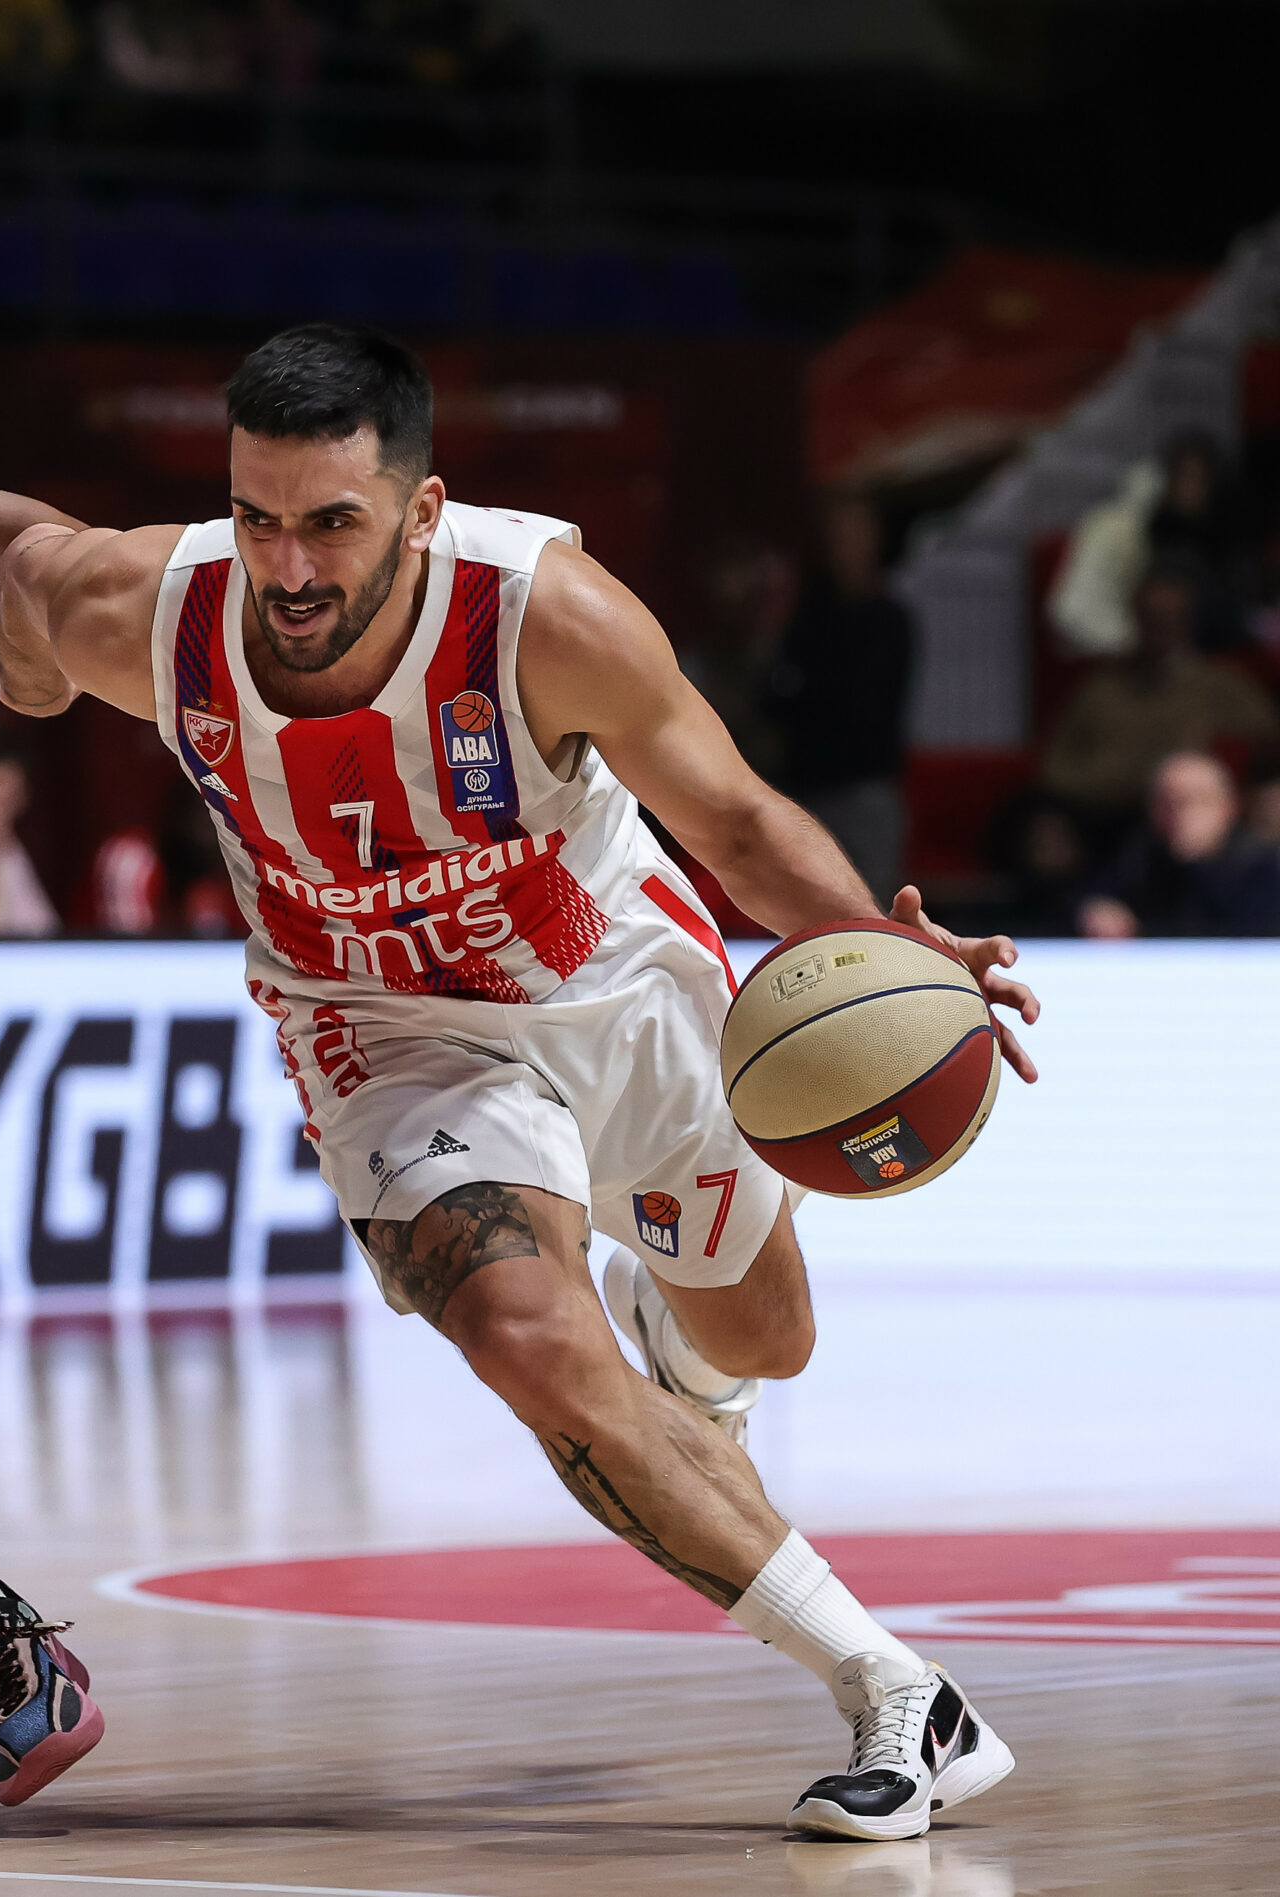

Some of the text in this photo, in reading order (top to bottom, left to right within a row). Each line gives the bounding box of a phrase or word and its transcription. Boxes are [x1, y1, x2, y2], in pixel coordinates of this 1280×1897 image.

[452, 735, 493, 762] ABA
[456, 801, 505, 813] ОСИГУРАЊЕ
[466, 794, 493, 805] ДУНАВ
[329, 800, 375, 868] 7
[264, 831, 550, 914] meridian
[321, 897, 513, 976] mts
[843, 1124, 900, 1155] ADMIRAL
[868, 1143, 899, 1165] ABA
[696, 1167, 739, 1258] 7
[641, 1221, 675, 1253] ABA
